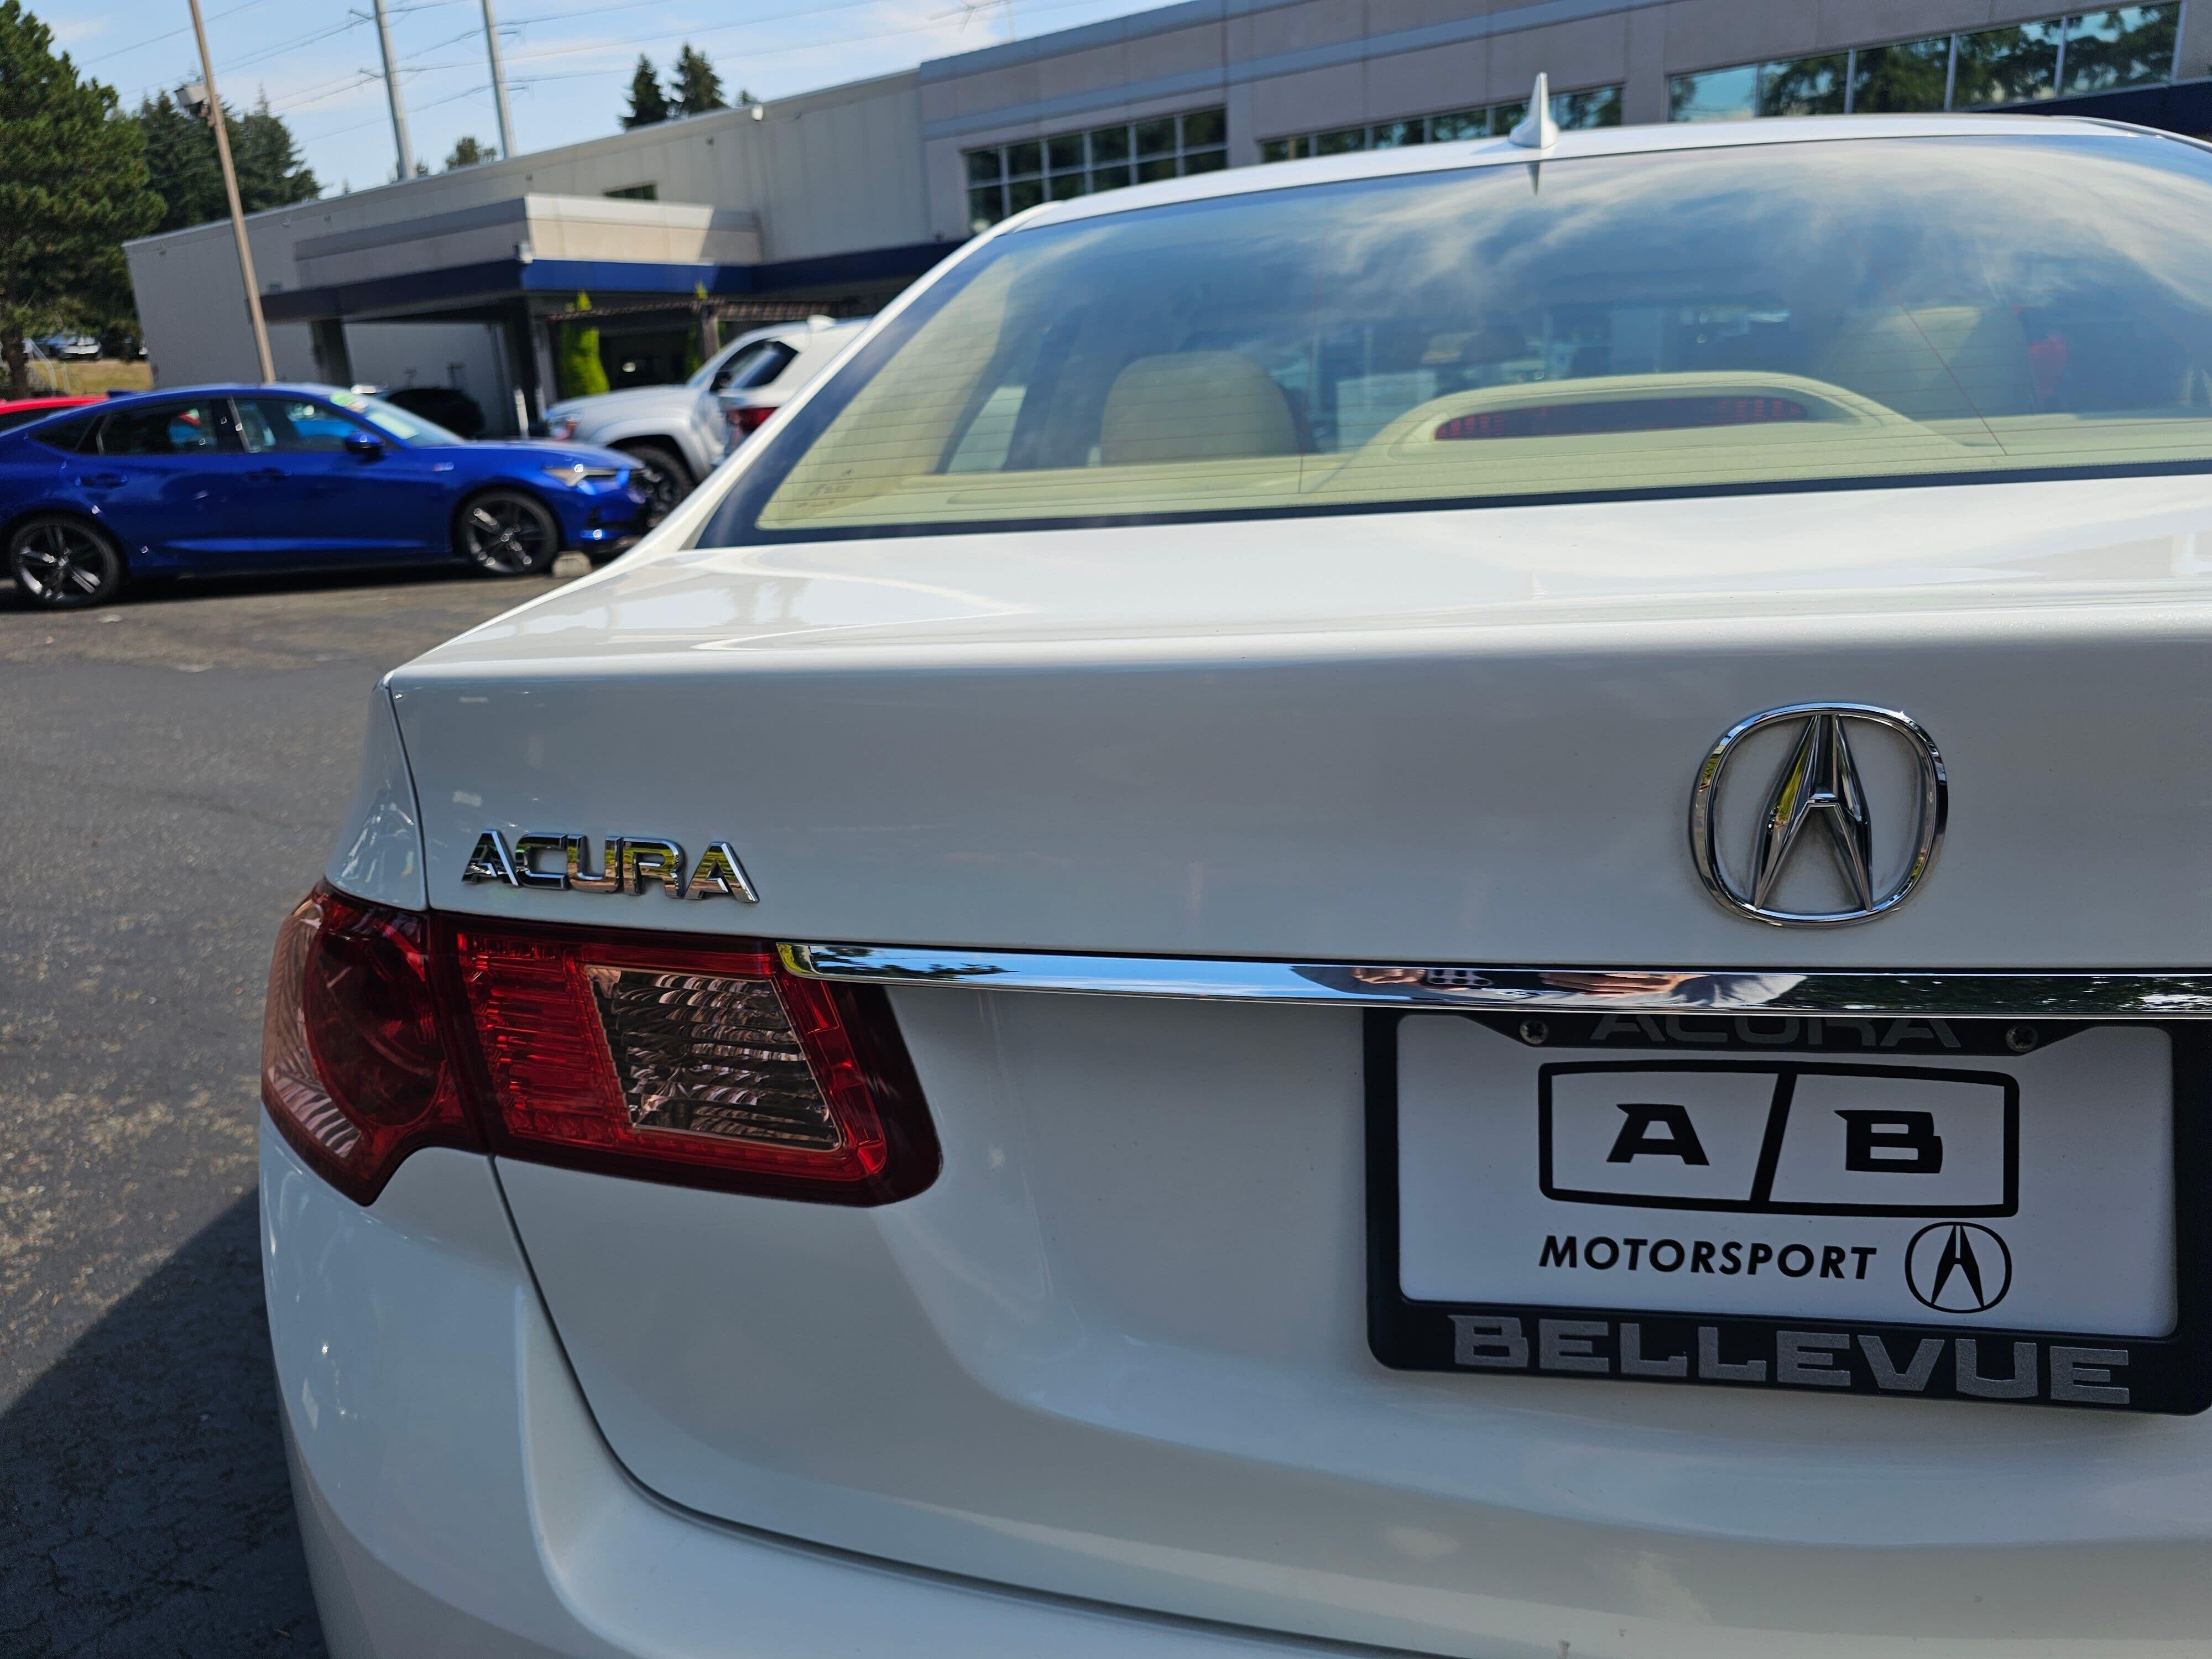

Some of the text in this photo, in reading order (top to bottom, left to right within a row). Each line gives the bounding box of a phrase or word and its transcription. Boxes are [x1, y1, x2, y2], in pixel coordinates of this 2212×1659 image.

[461, 829, 760, 904] ACURA
[1606, 1103, 1943, 1174] A B
[1538, 1235, 1877, 1280] MOTORSPORT
[1447, 1314, 2131, 1405] BELLEVUE
